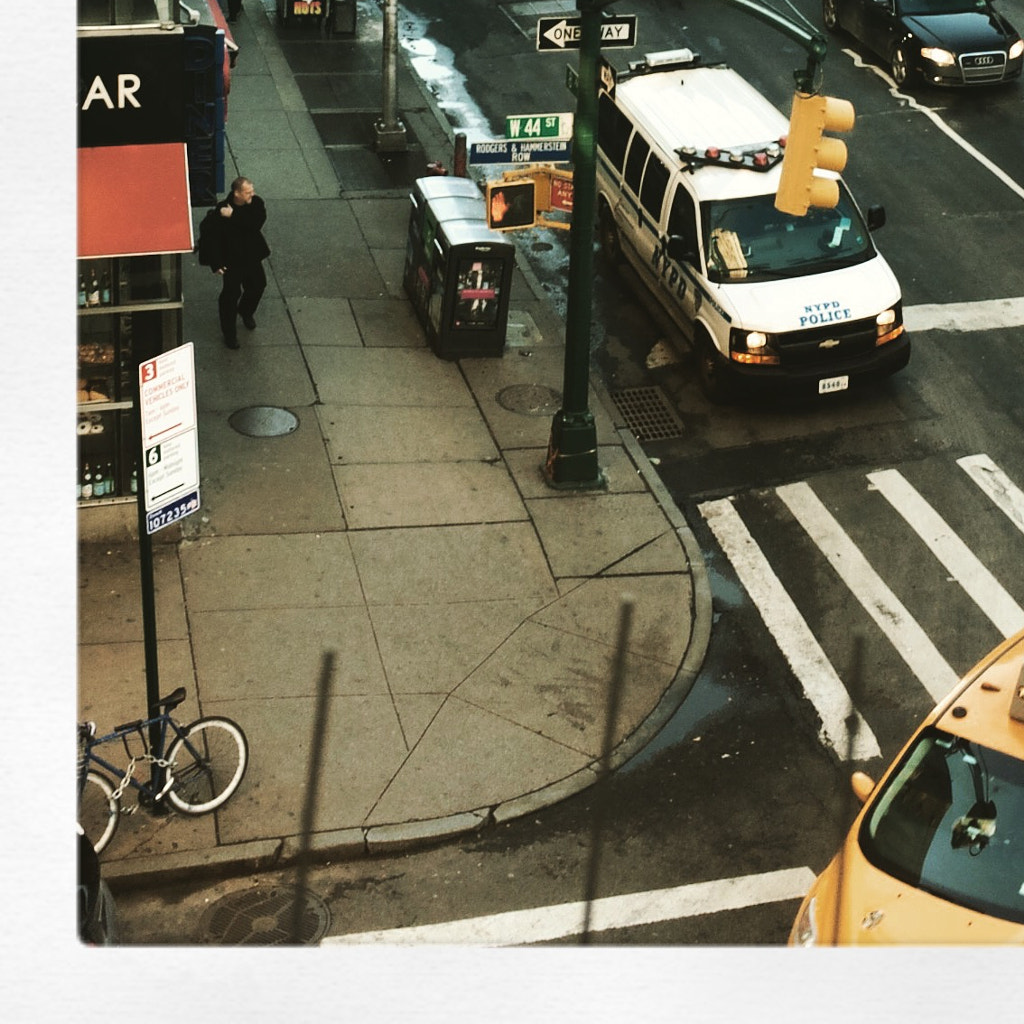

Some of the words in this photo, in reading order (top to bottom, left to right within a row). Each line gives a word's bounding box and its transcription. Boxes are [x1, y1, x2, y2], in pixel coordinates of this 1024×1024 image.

[601, 26, 624, 39] AY
[82, 73, 142, 110] AR
[509, 120, 520, 137] W
[523, 119, 541, 137] 44
[545, 117, 557, 127] ST
[476, 144, 508, 154] RODGERS
[511, 143, 517, 152] &
[520, 141, 567, 152] HAMMERSTEIN
[511, 151, 531, 162] ROW
[804, 301, 840, 313] NYPD
[799, 309, 852, 327] POLICE
[144, 363, 155, 381] 3
[144, 376, 186, 397] COMMERCIAL
[145, 387, 174, 405] VEHICLES
[175, 381, 189, 394] ONLY
[148, 447, 158, 465] 6
